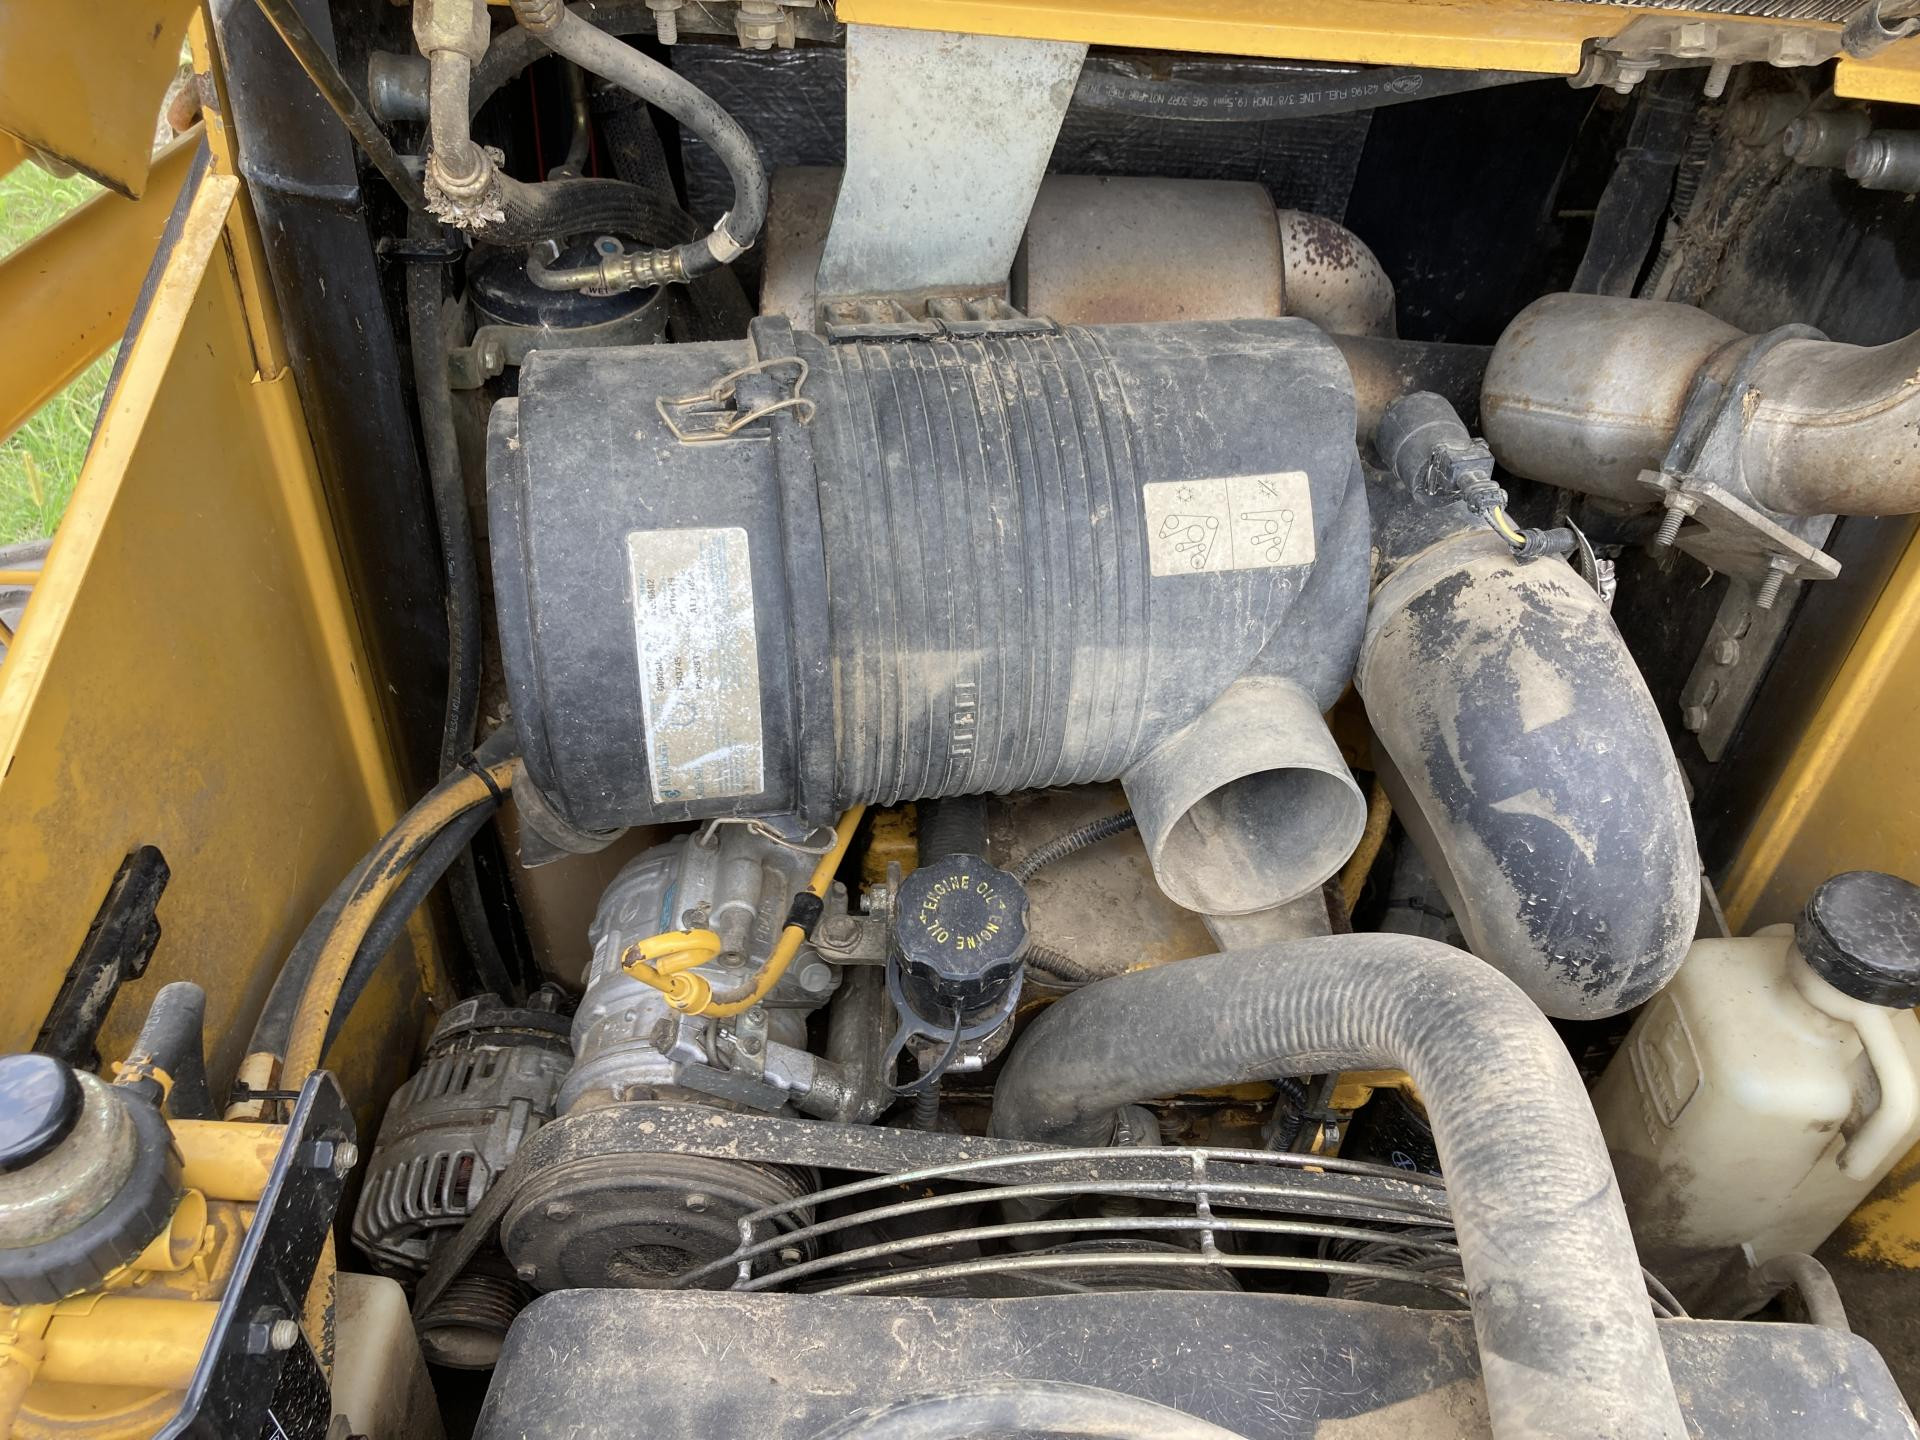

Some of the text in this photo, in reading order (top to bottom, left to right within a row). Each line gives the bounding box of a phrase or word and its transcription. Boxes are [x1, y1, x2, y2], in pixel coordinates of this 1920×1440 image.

[1149, 93, 1165, 104] NOT
[1278, 94, 1296, 105] 3/8
[1299, 91, 1322, 104] LINE
[1325, 88, 1348, 100] FUEL
[1167, 96, 1189, 106] 30R7
[1192, 96, 1209, 107] SAE
[1252, 95, 1274, 107] INCH
[923, 875, 999, 911] ENGINE OIL
[926, 914, 1004, 951] ENGINE OIL
